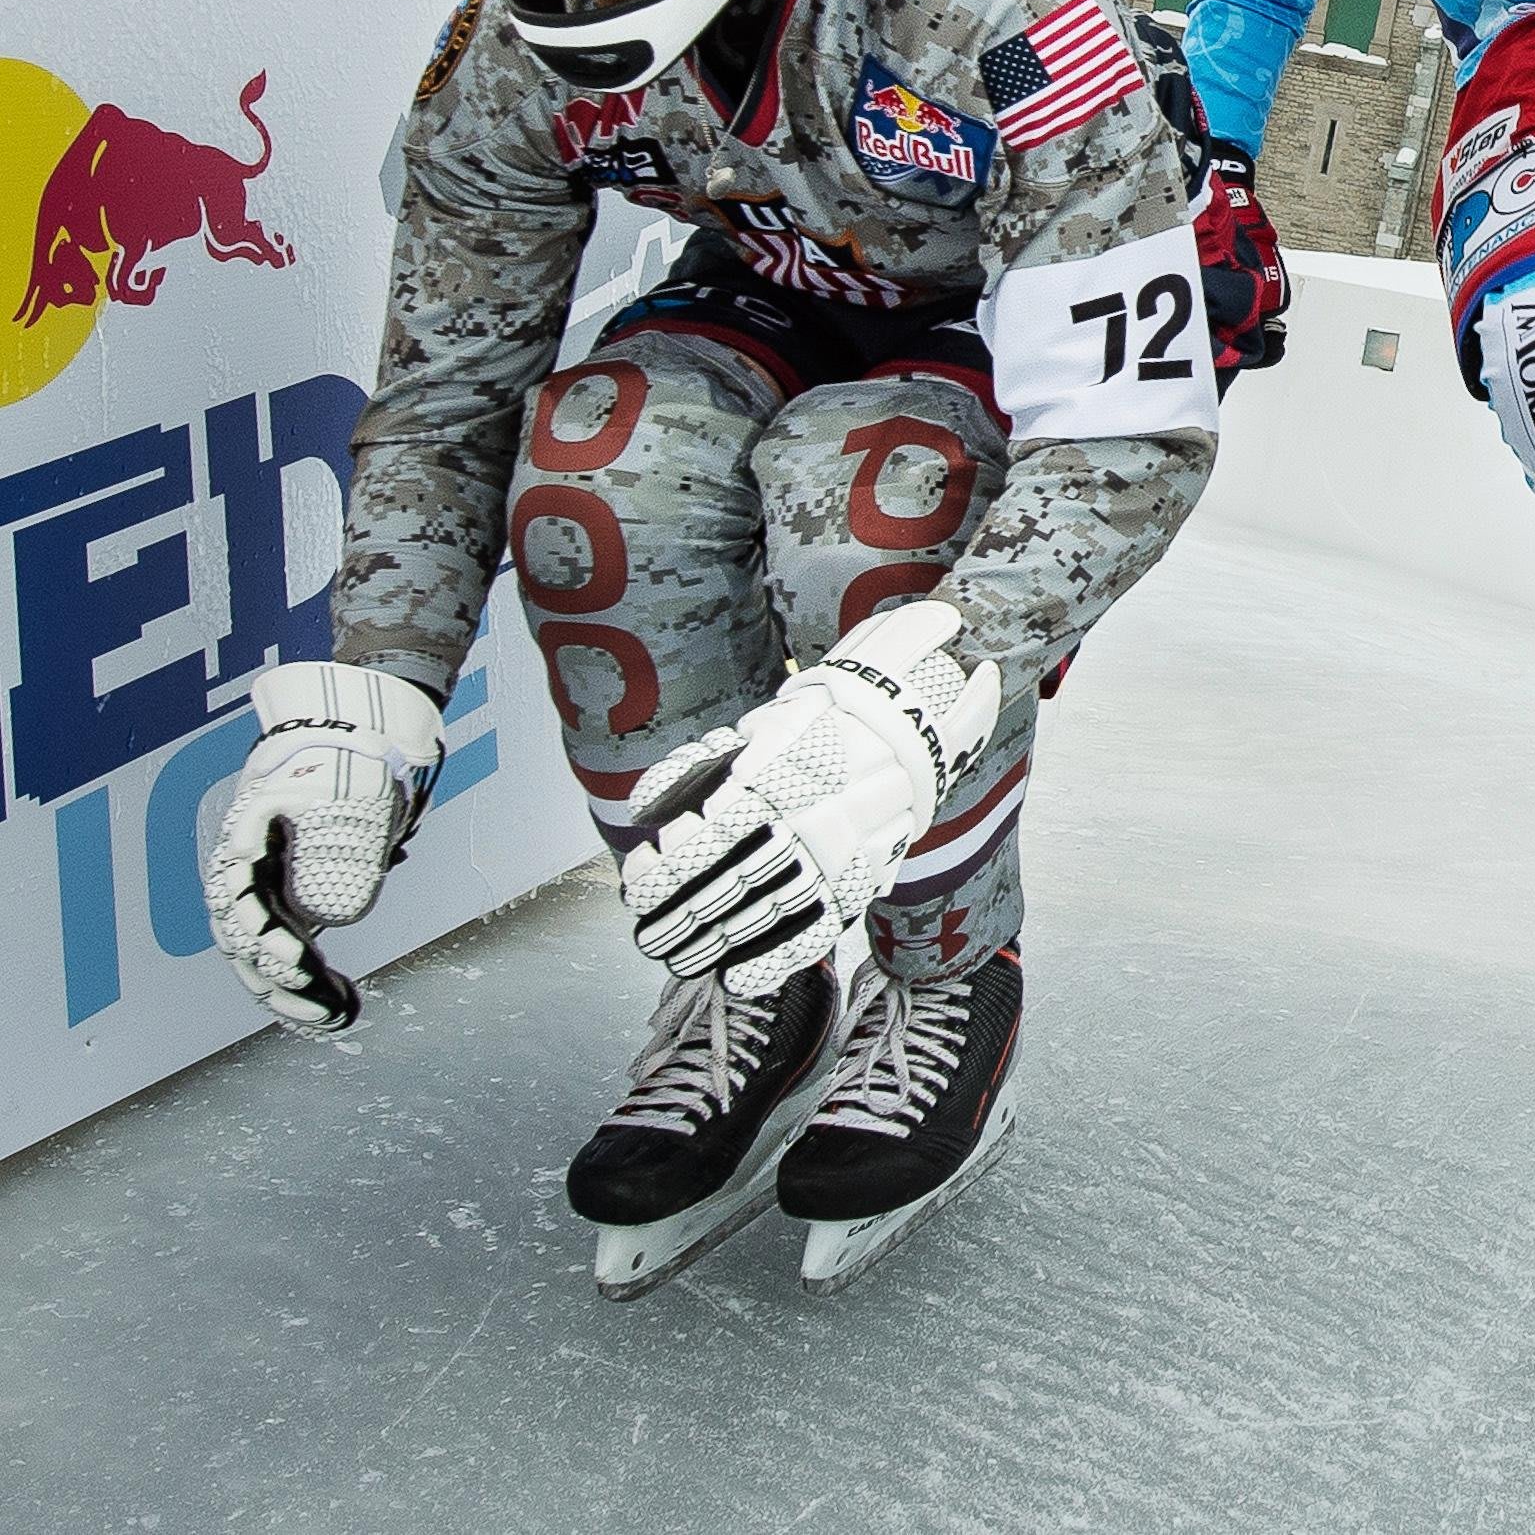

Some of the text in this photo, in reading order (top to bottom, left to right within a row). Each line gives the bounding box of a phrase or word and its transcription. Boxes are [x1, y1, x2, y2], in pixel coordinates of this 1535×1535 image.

[855, 116, 977, 183] Red Bull
[740, 203, 838, 269] UA
[1069, 273, 1194, 383] 72
[0, 373, 372, 823] ED
[818, 658, 948, 806] NDER ARMO
